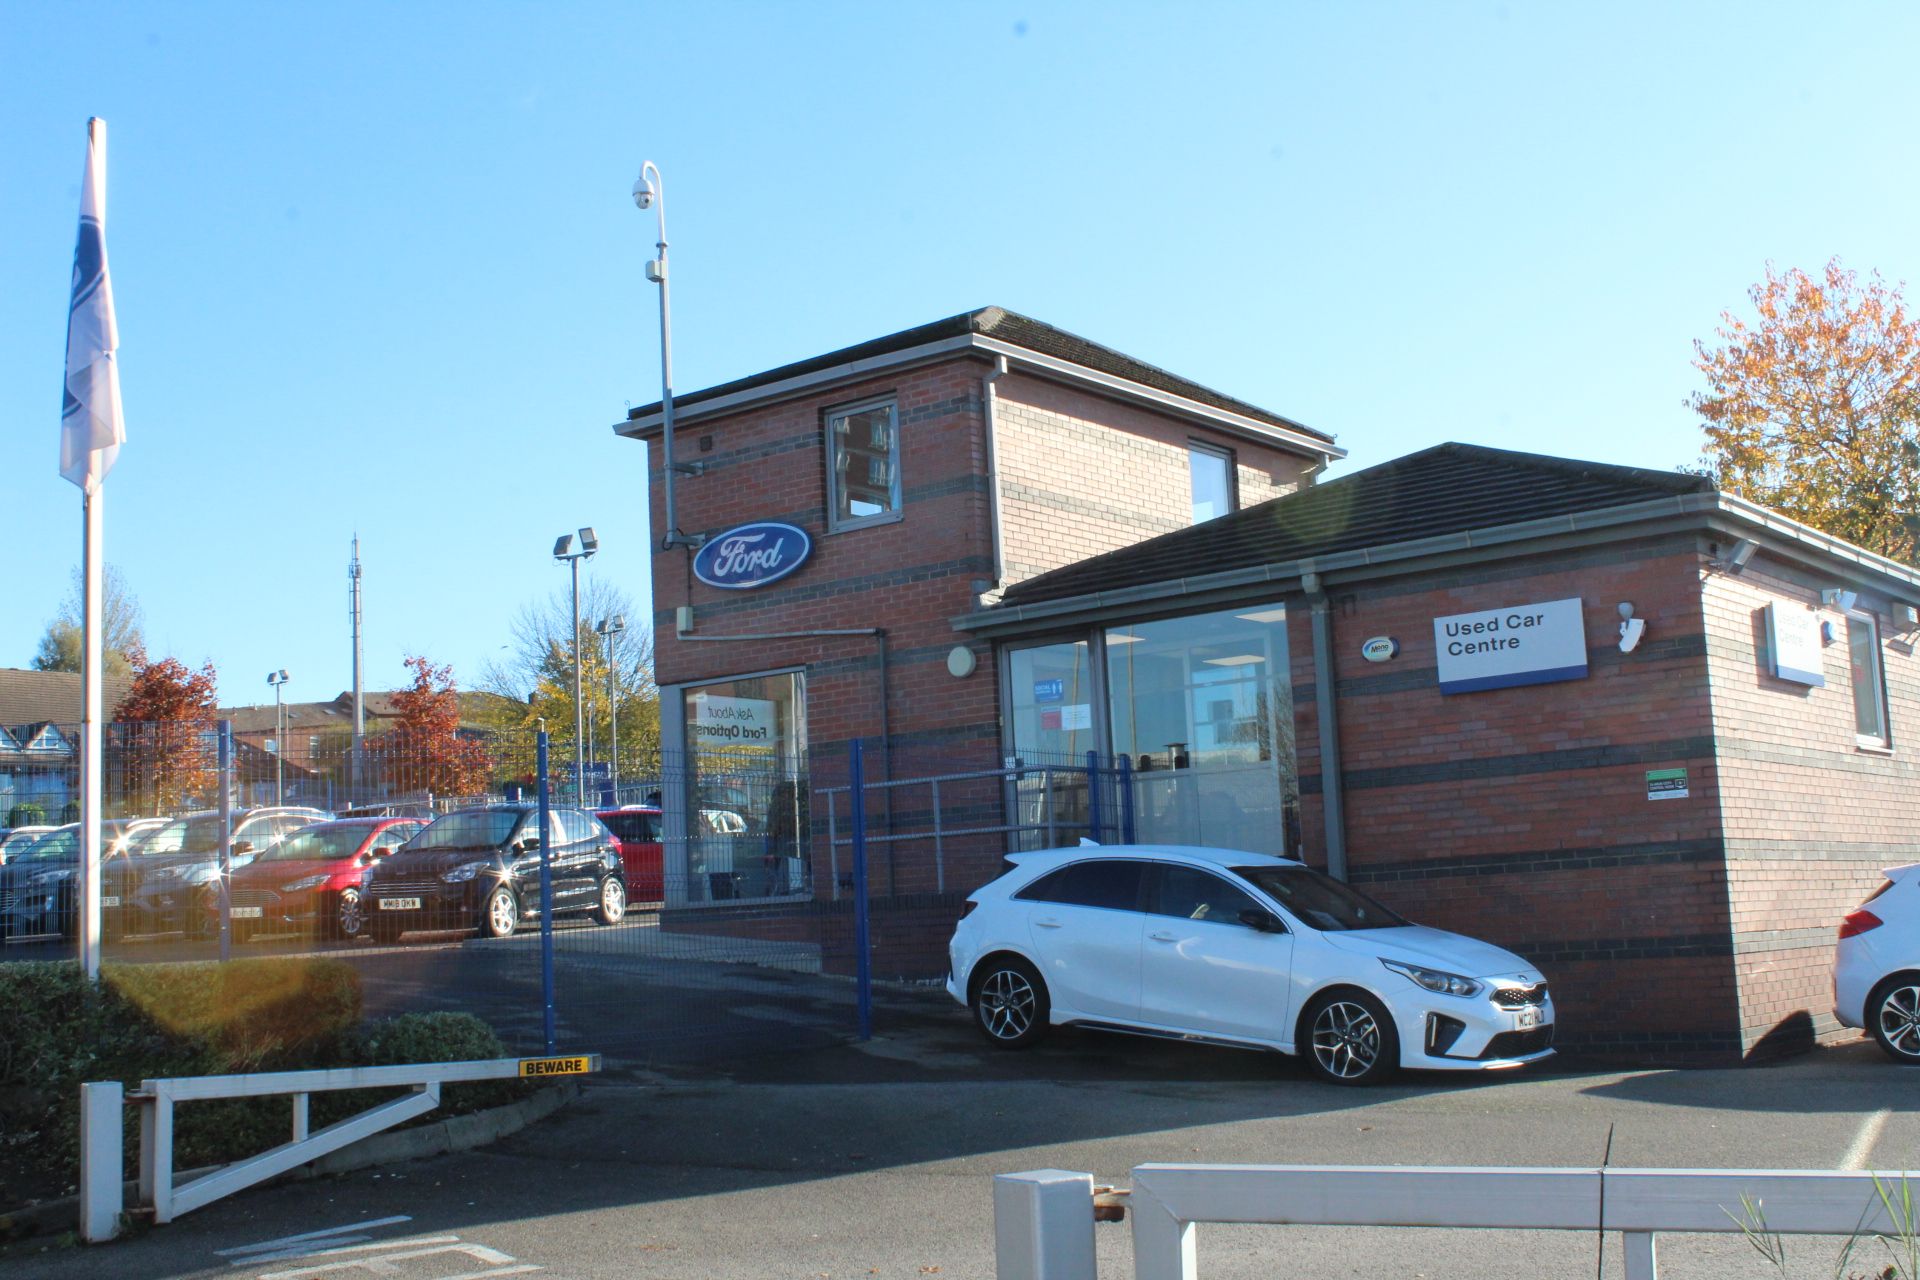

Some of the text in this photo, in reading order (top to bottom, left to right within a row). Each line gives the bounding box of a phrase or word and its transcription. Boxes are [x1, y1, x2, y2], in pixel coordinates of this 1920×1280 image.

[714, 533, 784, 577] Ford
[1446, 614, 1544, 637] Used Car
[1448, 637, 1520, 656] Centre
[526, 1060, 582, 1075] BEWARE
